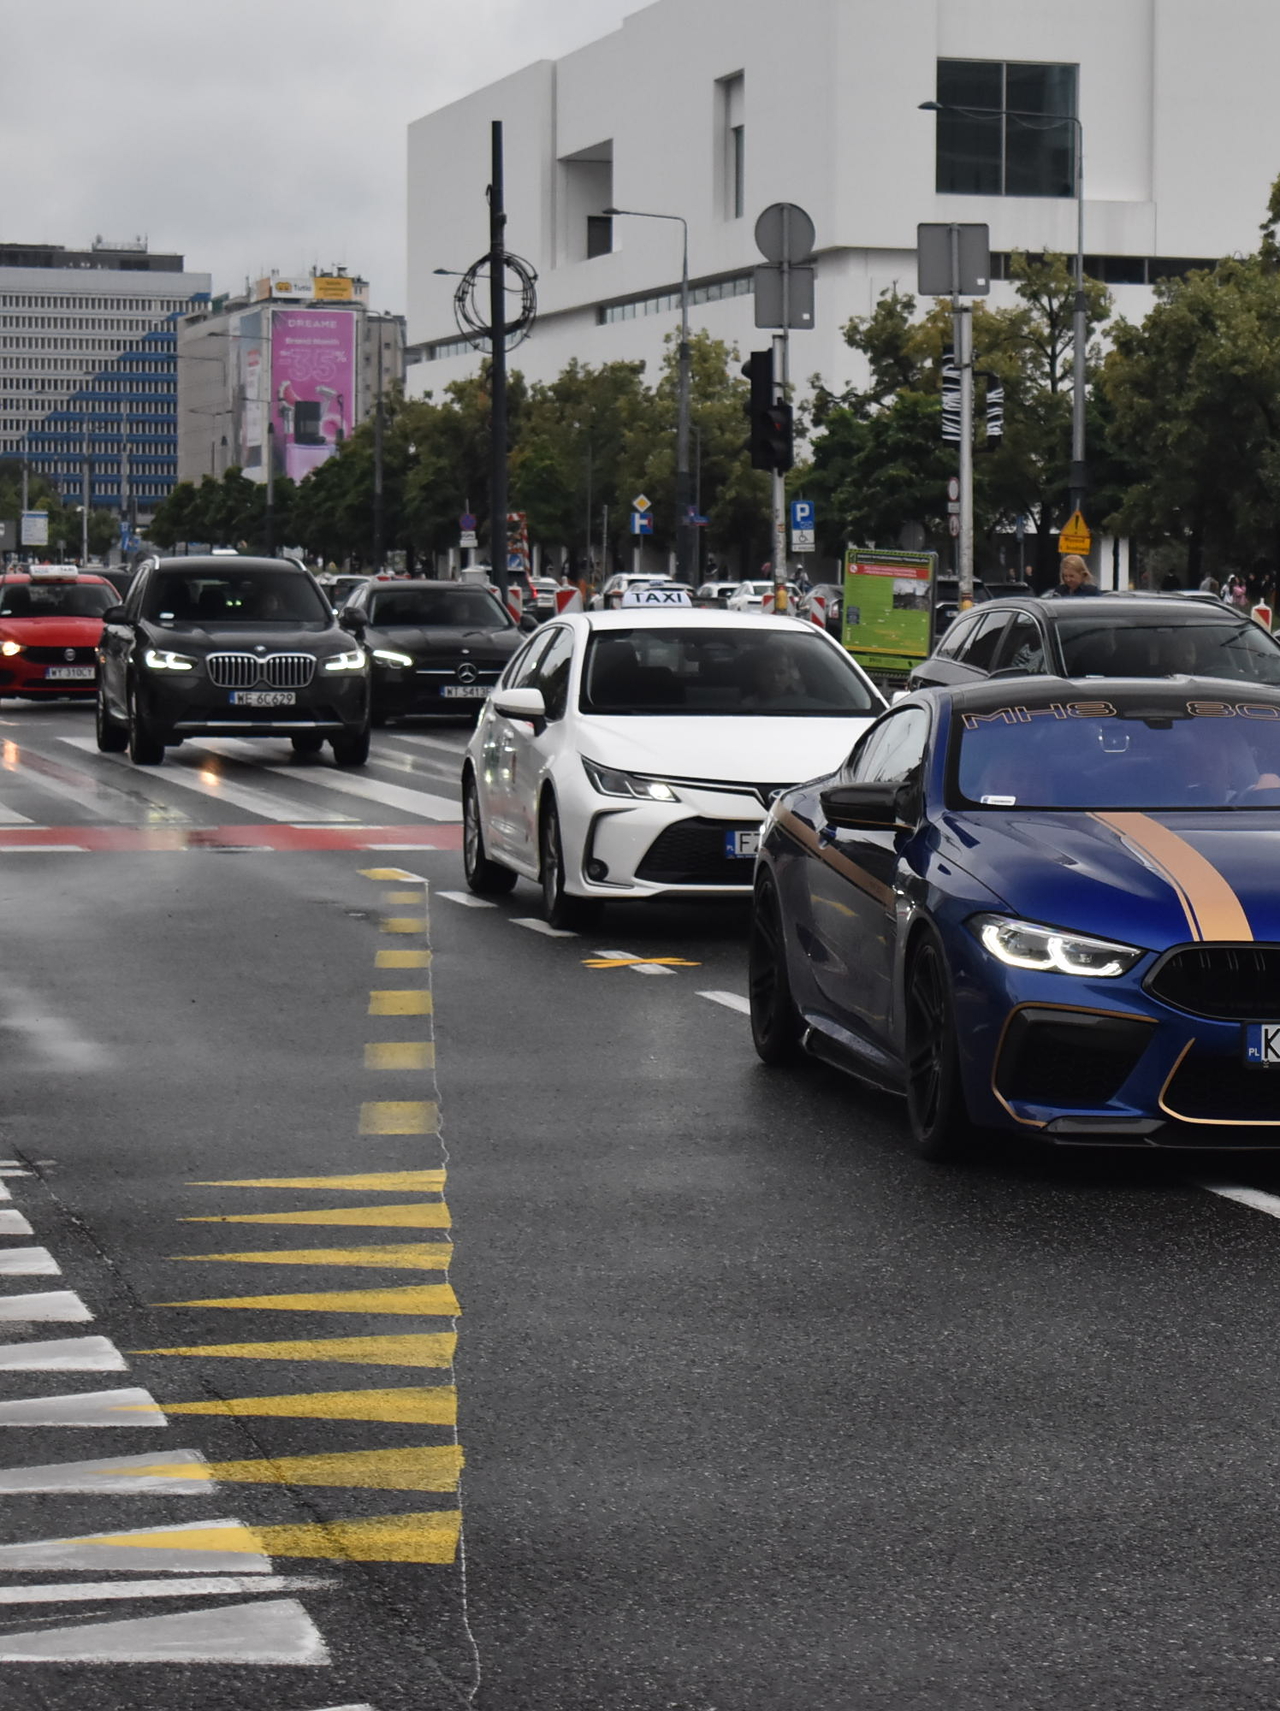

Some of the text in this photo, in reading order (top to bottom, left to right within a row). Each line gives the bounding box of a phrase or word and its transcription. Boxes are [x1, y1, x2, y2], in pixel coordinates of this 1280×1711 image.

[796, 503, 810, 522] P
[631, 592, 683, 603] TAXI
[237, 693, 294, 706] WE 6C629
[1248, 1048, 1260, 1057] PL
